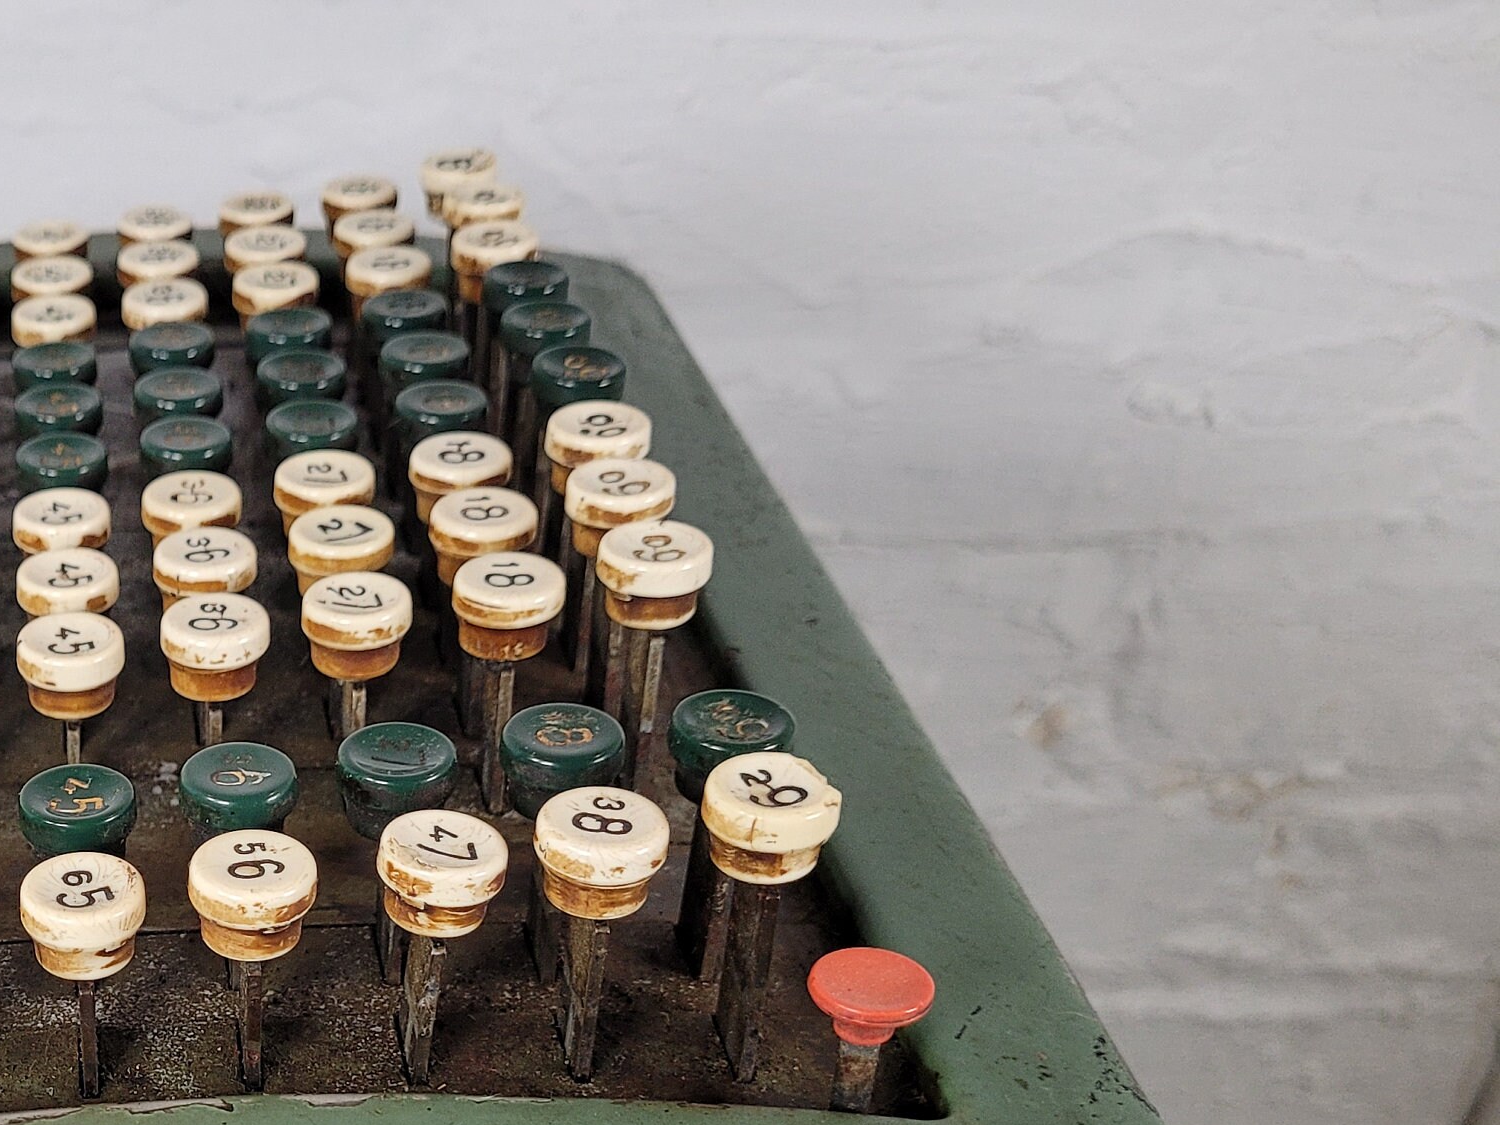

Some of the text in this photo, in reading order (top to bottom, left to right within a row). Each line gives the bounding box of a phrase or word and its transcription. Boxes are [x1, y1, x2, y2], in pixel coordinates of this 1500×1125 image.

[484, 562, 535, 588] 18
[188, 602, 239, 631] 36
[47, 627, 96, 655] 45
[739, 768, 809, 808] 29
[571, 796, 633, 835] 38
[227, 842, 286, 880] 56
[416, 825, 479, 861] 47
[56, 869, 116, 909] 65
